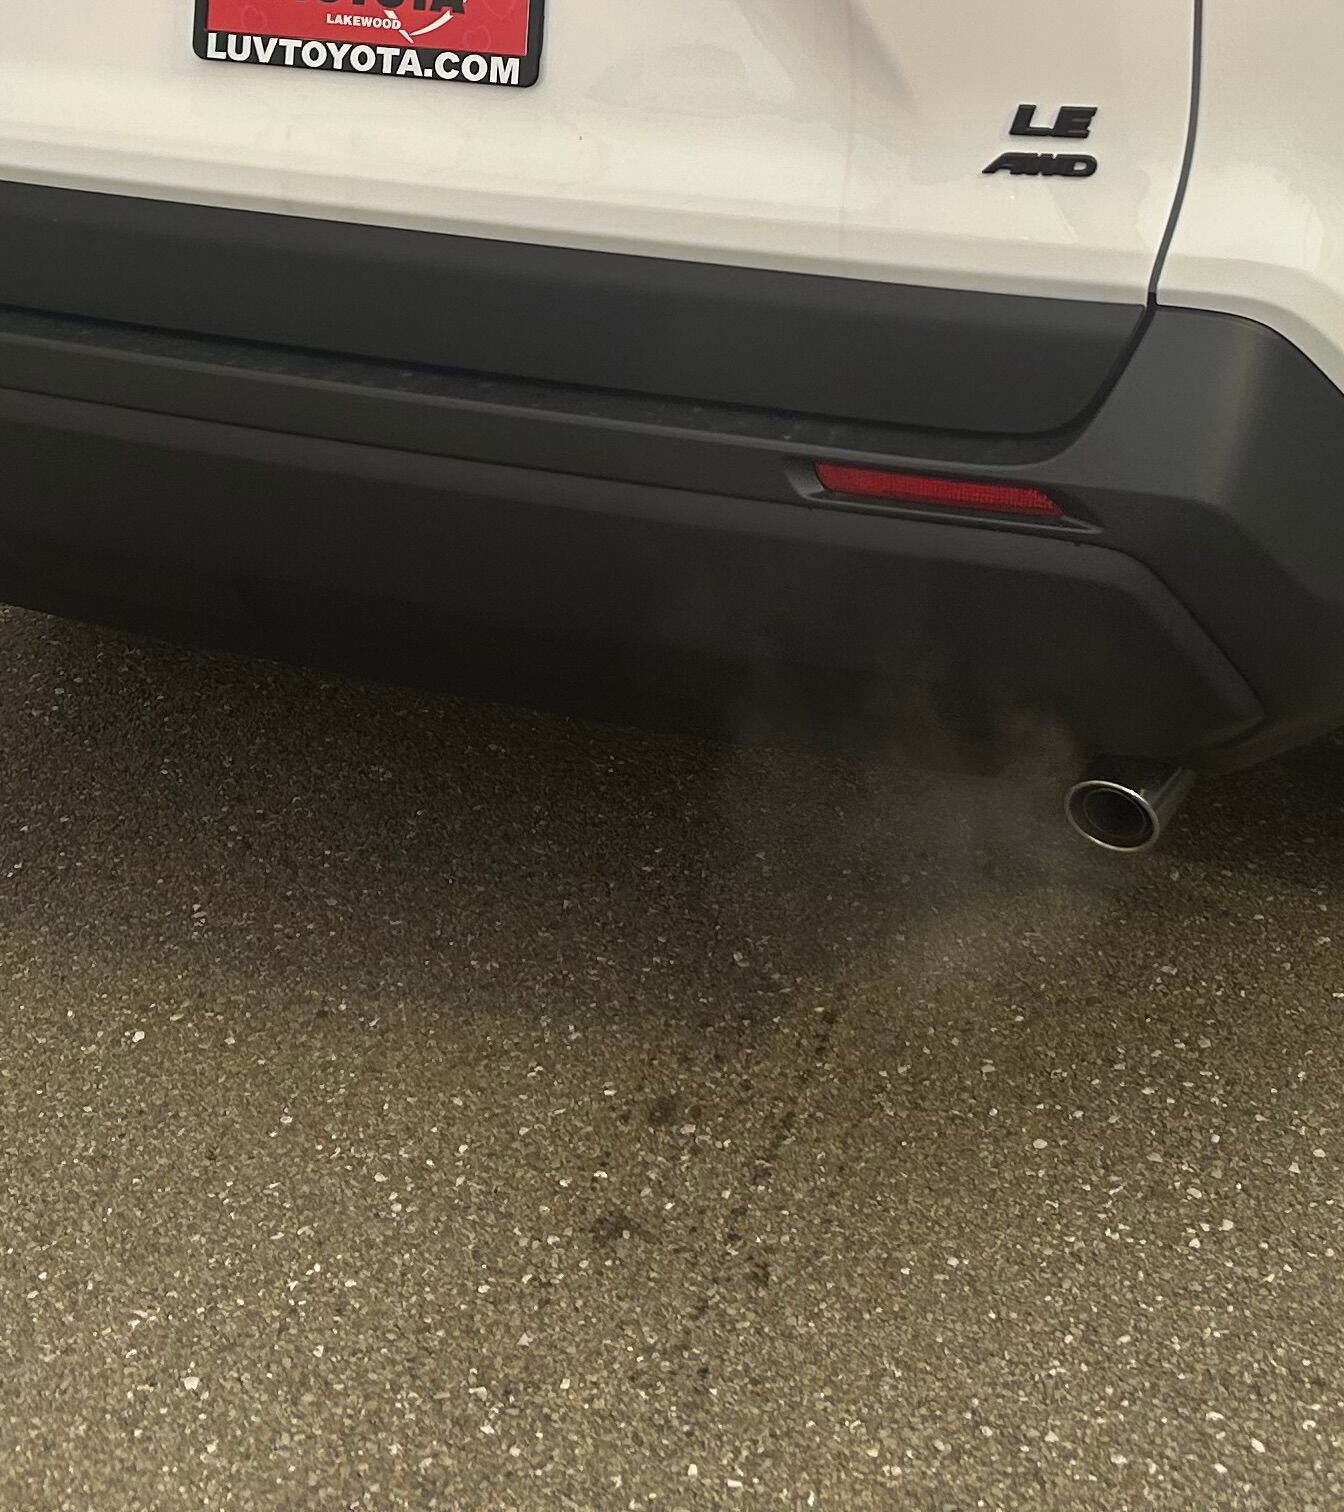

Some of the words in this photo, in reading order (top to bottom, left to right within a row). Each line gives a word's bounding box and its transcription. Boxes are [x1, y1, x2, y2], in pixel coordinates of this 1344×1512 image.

[326, 13, 402, 31] LAKEWOOD
[206, 32, 521, 86] LUVTOYOTA.COM
[1009, 104, 1098, 139] LE
[982, 152, 1098, 177] AWD
